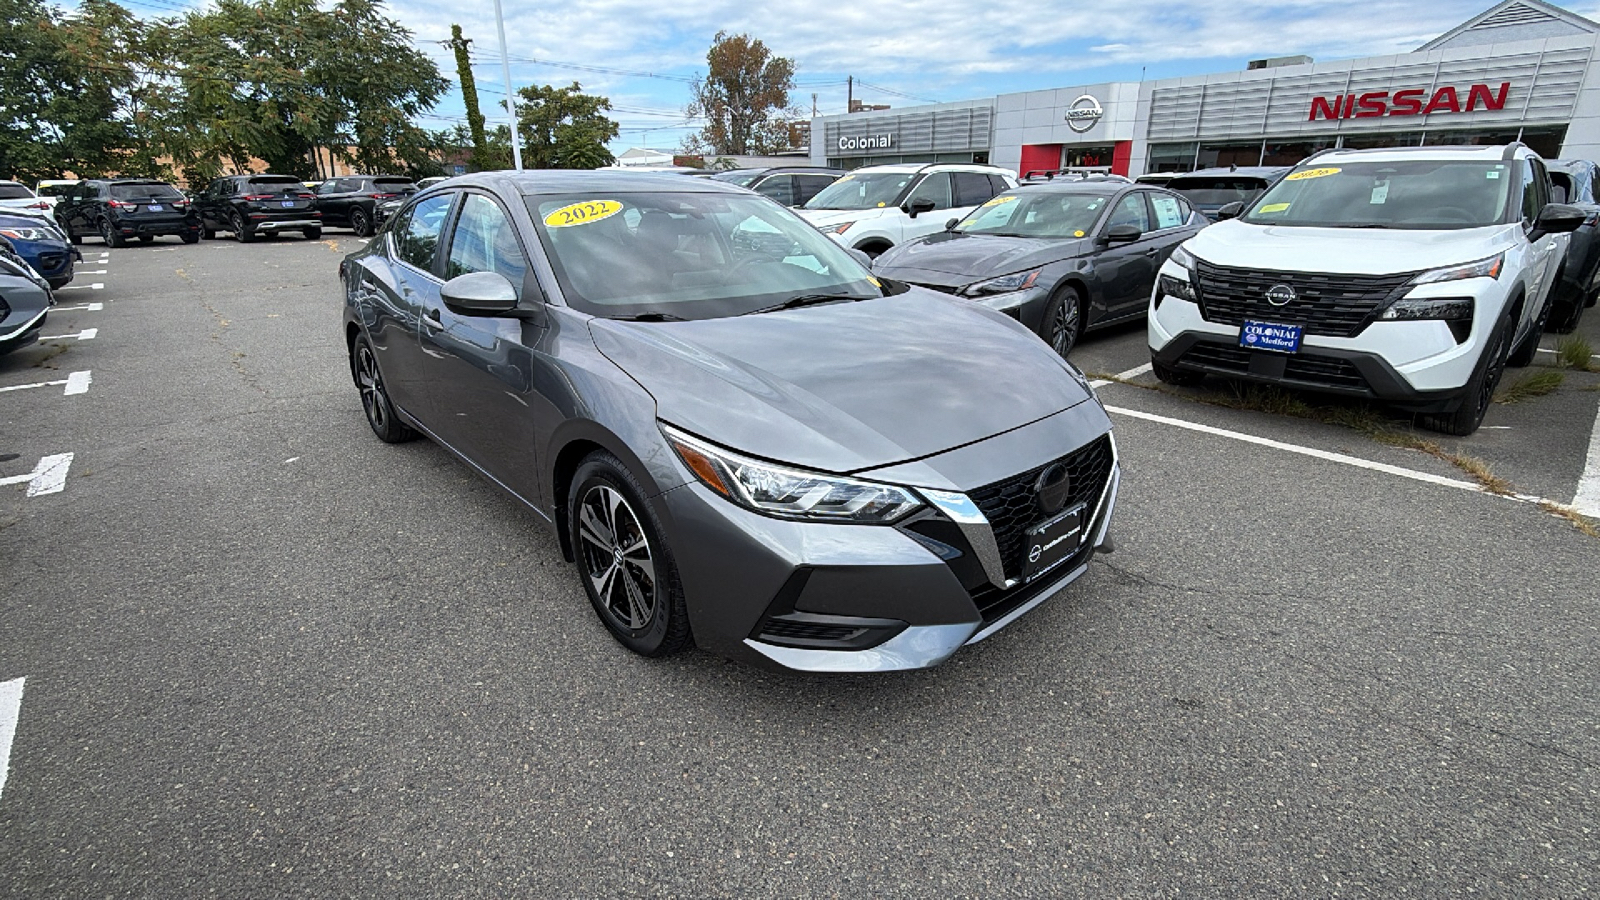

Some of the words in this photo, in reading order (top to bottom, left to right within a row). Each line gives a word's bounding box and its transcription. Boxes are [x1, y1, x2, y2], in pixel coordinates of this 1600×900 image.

[1309, 82, 1510, 121] NISSAN
[1068, 109, 1099, 118] NISSAN
[839, 133, 892, 150] Colonial
[560, 202, 610, 223] 2022
[1245, 325, 1299, 339] COLONIAL
[1261, 336, 1294, 347] Medford
